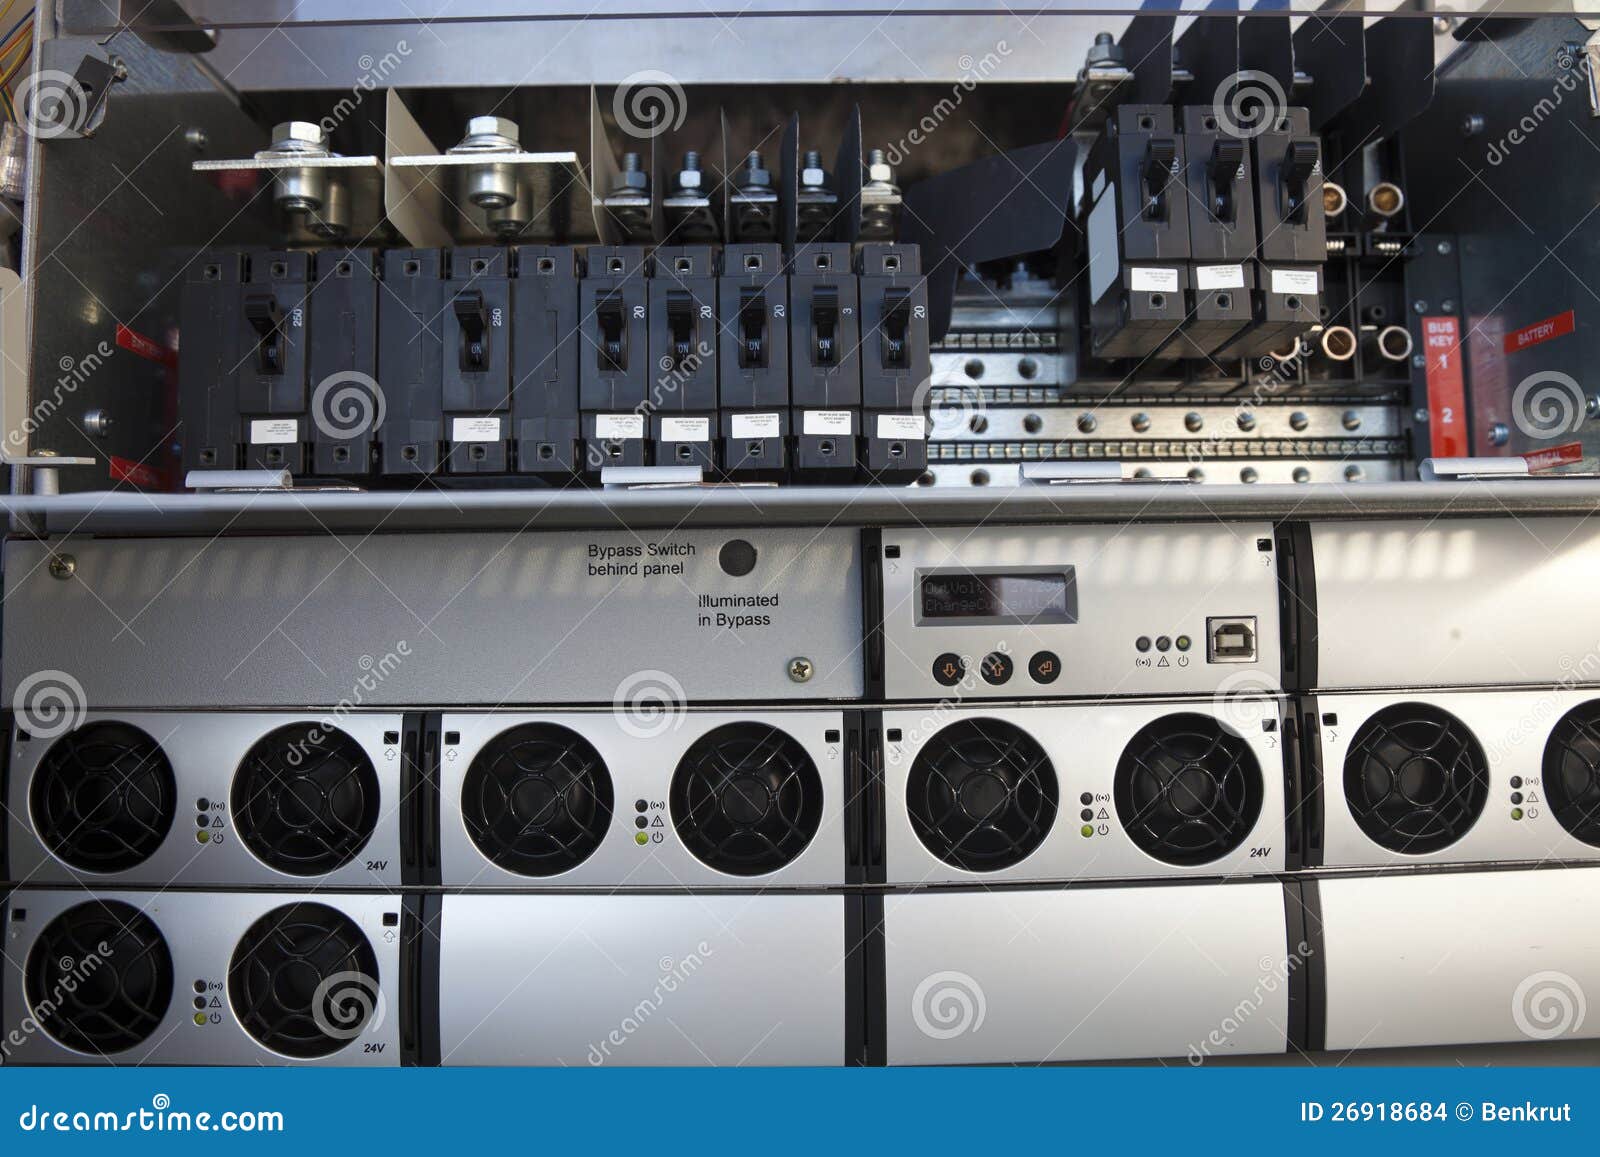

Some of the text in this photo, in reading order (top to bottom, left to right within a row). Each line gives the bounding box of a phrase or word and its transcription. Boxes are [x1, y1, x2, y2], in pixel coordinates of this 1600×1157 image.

[633, 305, 645, 319] 20
[700, 305, 712, 319] 20
[774, 304, 785, 317] 20
[842, 307, 852, 315] 3
[914, 305, 925, 319] 20
[292, 308, 303, 327] 250
[492, 308, 502, 327] 250
[1427, 321, 1454, 334] BUS
[1517, 321, 1555, 346] BATTERY
[748, 341, 760, 351] ON
[819, 339, 831, 350] ON
[889, 341, 900, 351] ON
[1428, 335, 1454, 347] KEY
[609, 343, 620, 353] ON
[678, 344, 689, 354] ON
[1439, 353, 1448, 369] 1
[1441, 407, 1453, 423] 2
[588, 543, 696, 560] Bypass Switch
[588, 561, 684, 578] behind panel
[698, 594, 779, 608] Illuminated
[698, 612, 771, 629] in Bypass
[1249, 847, 1272, 858] 24V
[366, 860, 388, 871] 24V
[363, 1043, 386, 1053] 24V
